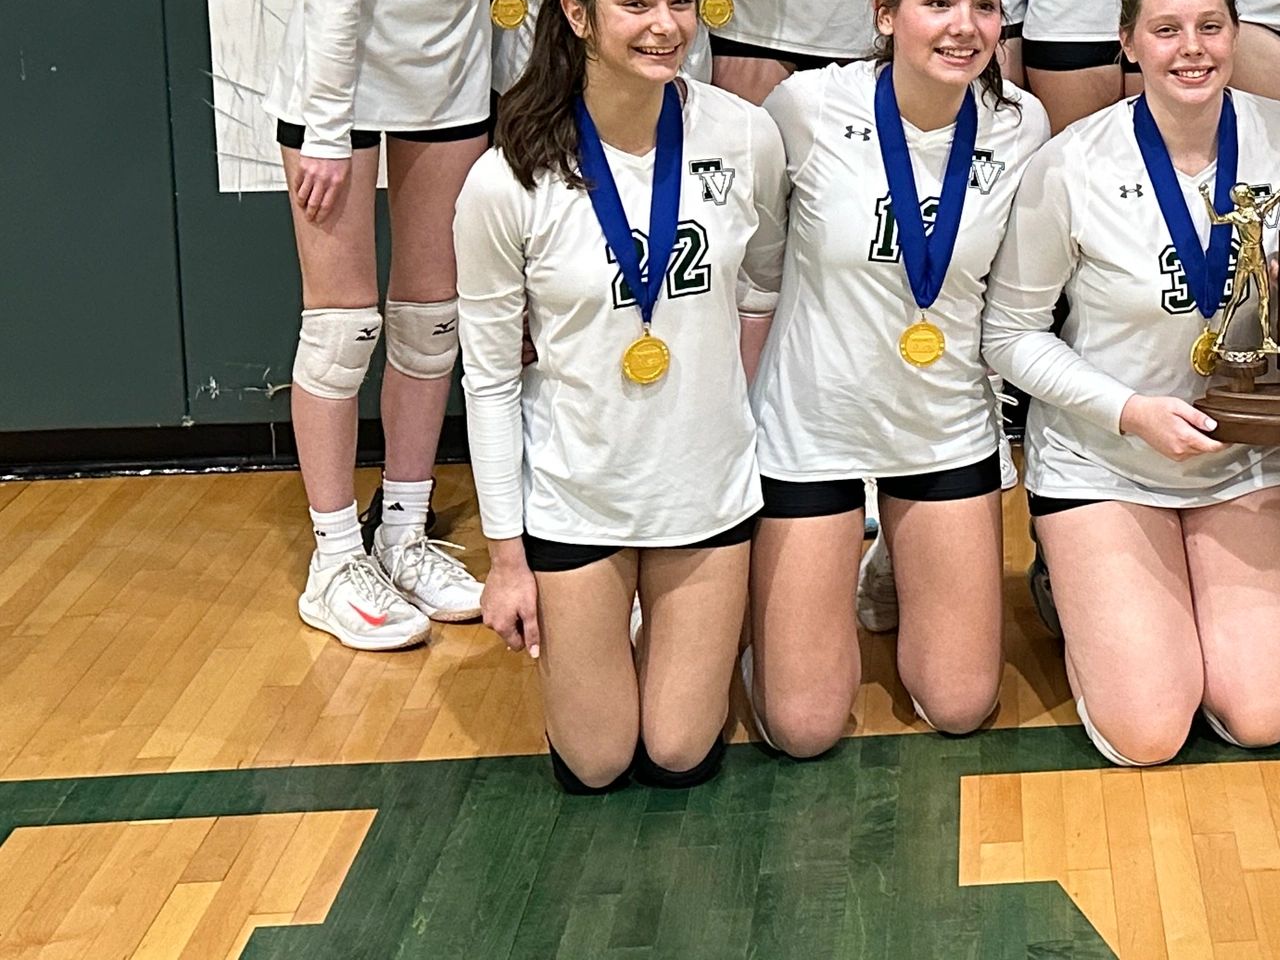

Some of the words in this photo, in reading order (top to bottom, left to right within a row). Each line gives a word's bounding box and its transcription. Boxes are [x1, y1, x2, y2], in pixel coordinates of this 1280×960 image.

[689, 157, 735, 206] TV
[868, 190, 941, 264] 1
[1158, 238, 1251, 316] 3
